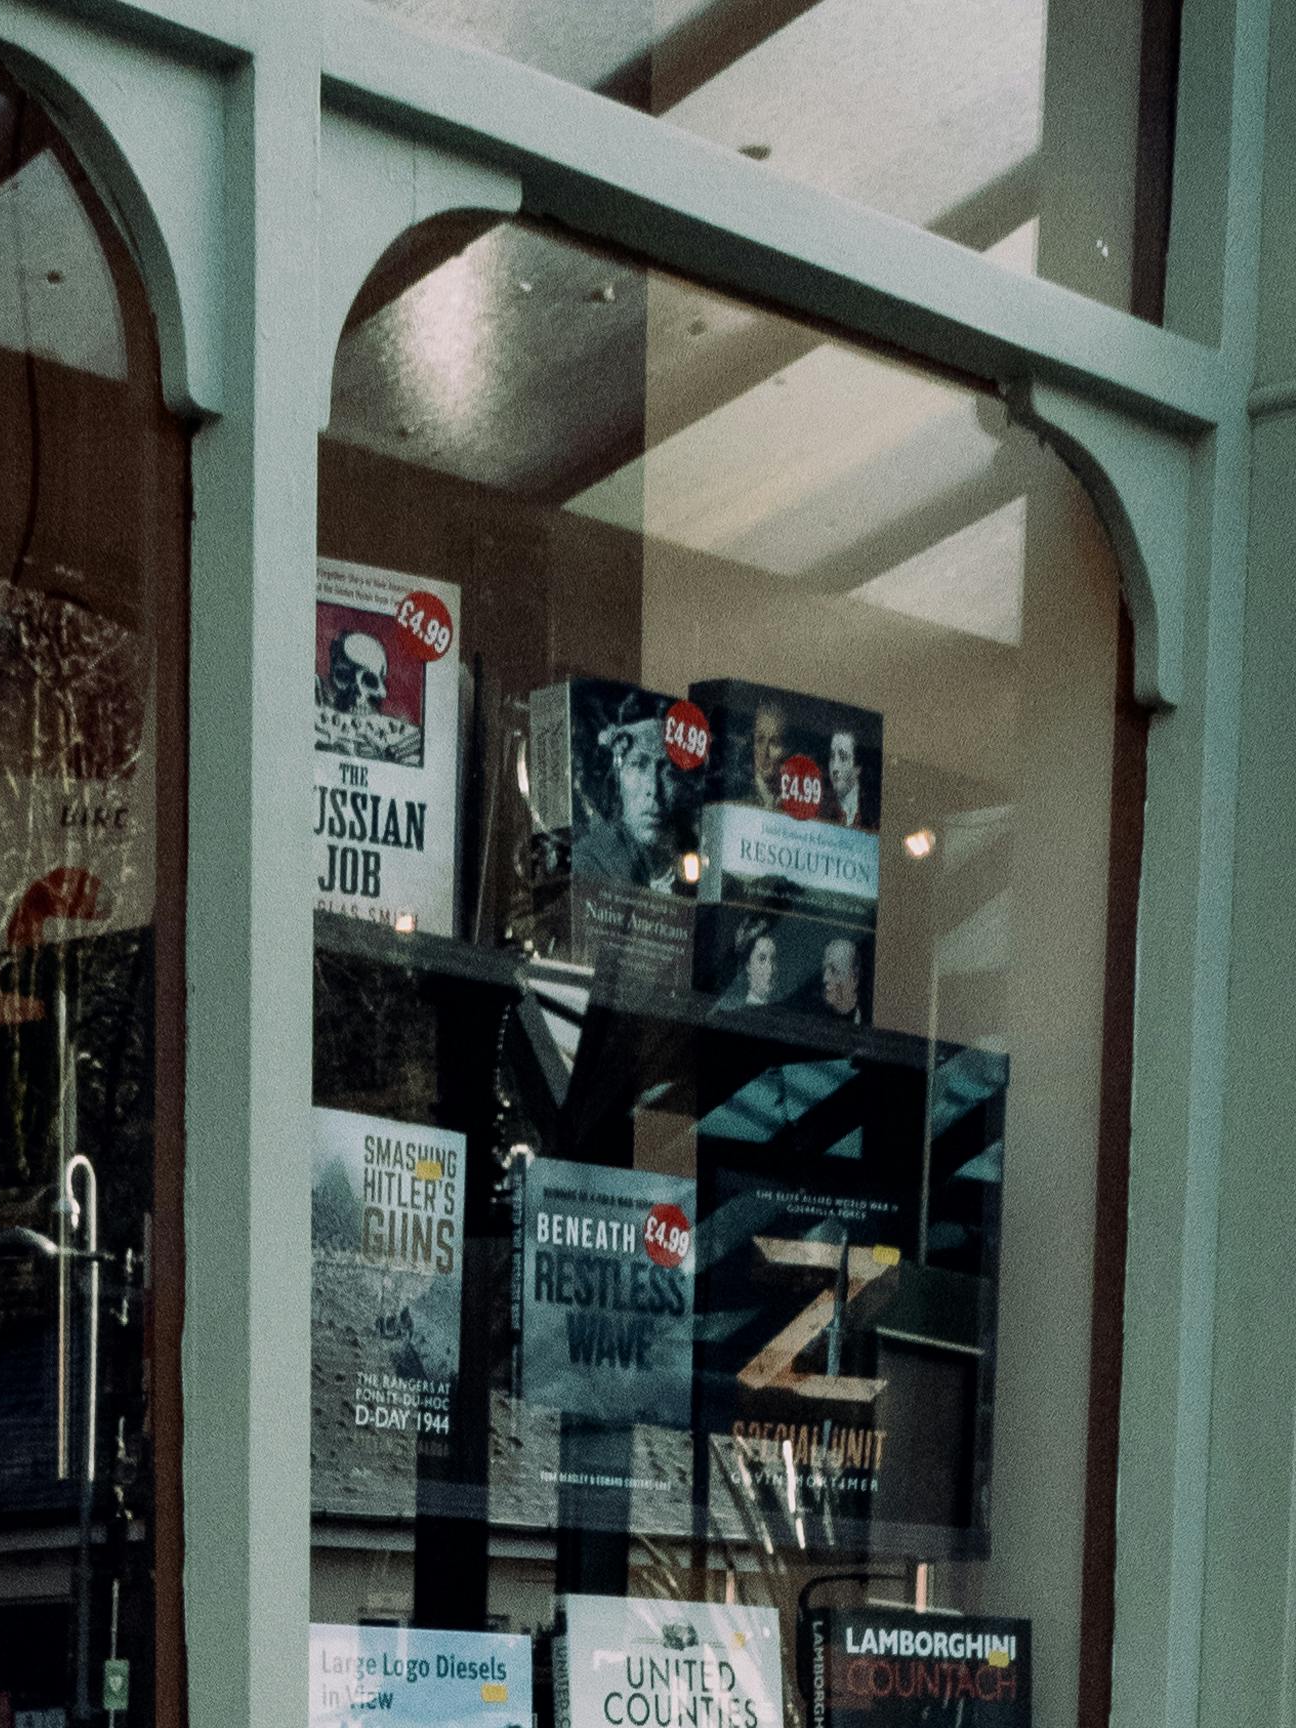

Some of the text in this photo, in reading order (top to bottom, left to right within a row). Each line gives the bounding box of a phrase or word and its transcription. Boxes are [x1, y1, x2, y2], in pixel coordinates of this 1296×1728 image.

[397, 600, 451, 654] £4.99
[665, 715, 708, 757] £4.99
[339, 763, 368, 787] THE
[780, 774, 821, 804] £4.99
[317, 844, 381, 898] JOB
[740, 837, 870, 883] RESOLUTION
[363, 1166, 455, 1216] HITLER'S
[361, 1205, 455, 1276] GUNS
[537, 1212, 636, 1253] BENEATH
[645, 1216, 689, 1257] £4.99
[535, 1251, 686, 1317] RESTLESS
[737, 1236, 901, 1402] Z
[357, 1372, 450, 1394] THE RANGERS AT
[355, 1405, 450, 1435] D-DAY 1944
[733, 1421, 887, 1470] SPECIAL UNIT
[846, 1627, 1016, 1661] LAMBORGHINI
[322, 1650, 507, 1682] Large Logo Diesels
[626, 1656, 735, 1693] UNITED
[847, 1659, 1016, 1700] COUNTACH
[345, 1686, 394, 1710] View
